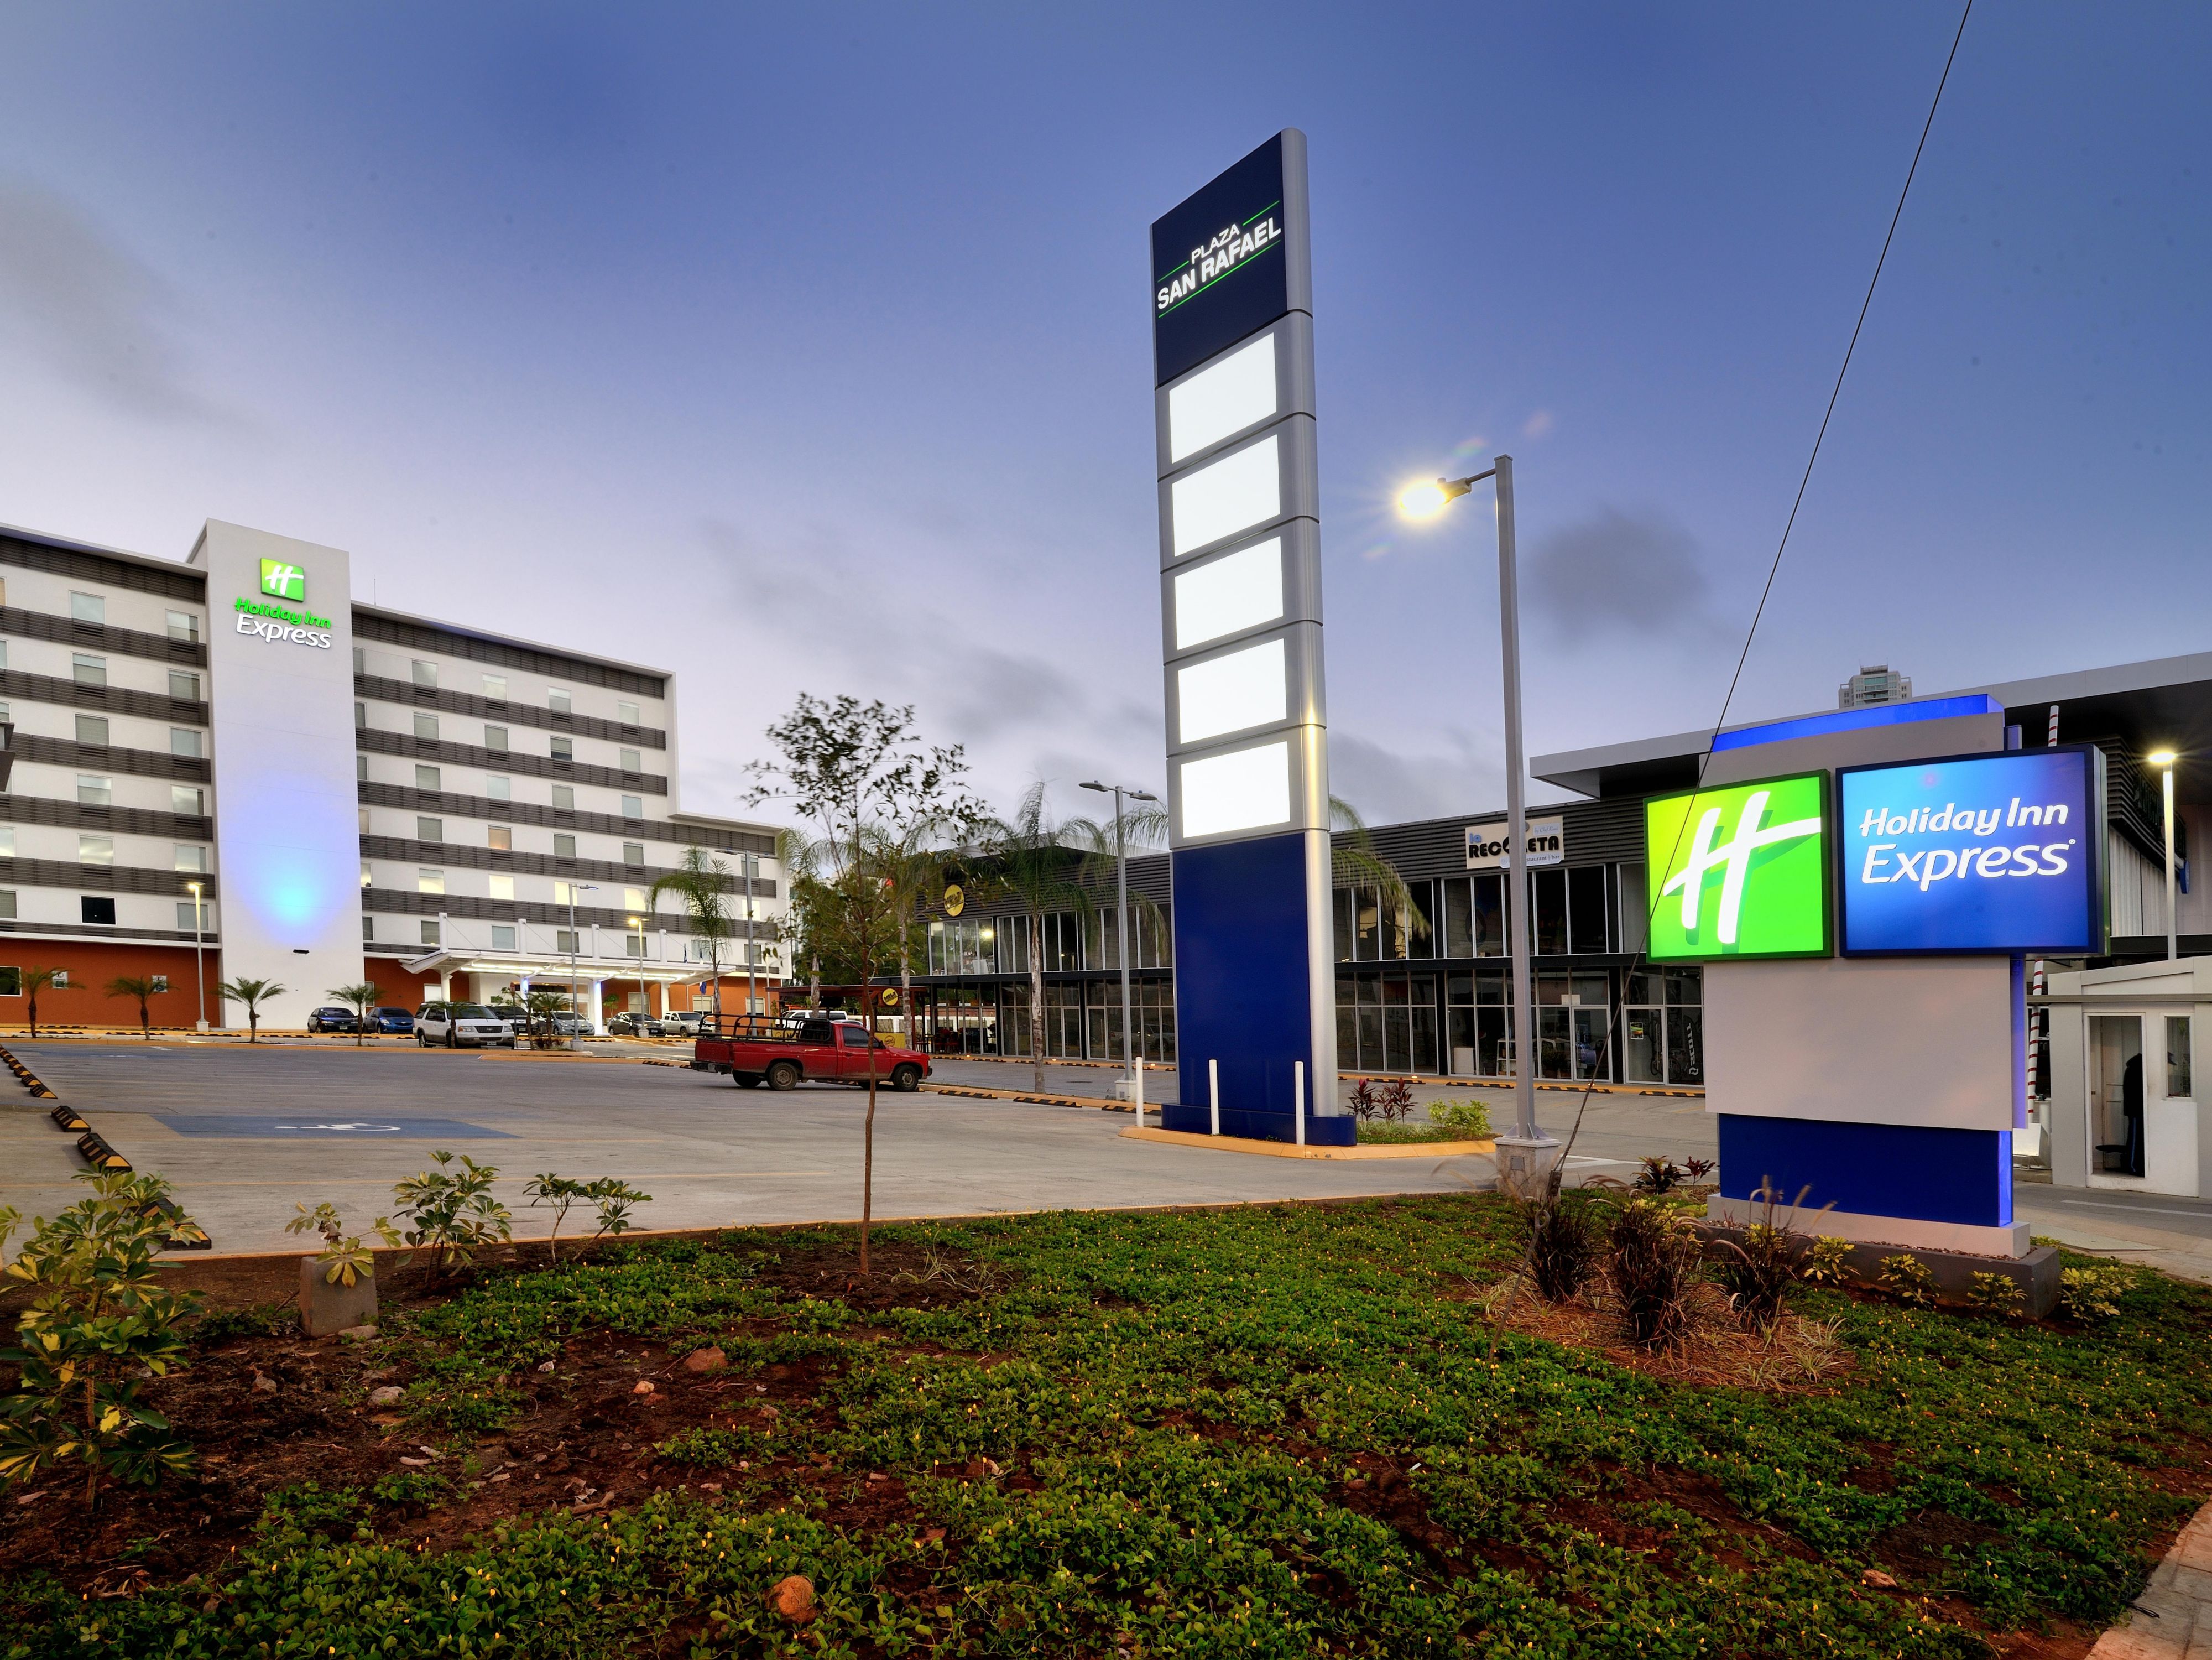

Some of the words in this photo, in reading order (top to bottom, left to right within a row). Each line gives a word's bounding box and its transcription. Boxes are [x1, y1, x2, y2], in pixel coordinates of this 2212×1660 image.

[1191, 223, 1240, 265] PLAZA
[1157, 268, 1196, 309] SAN
[1201, 217, 1281, 283] RAFAEL
[234, 597, 302, 625] Holiday
[305, 610, 331, 629] Inn
[236, 613, 332, 649] Express
[1859, 803, 2002, 837] Holiday
[2006, 797, 2069, 828] Inn
[1469, 836, 1559, 858] RECETA
[884, 991, 896, 1000] MELT
